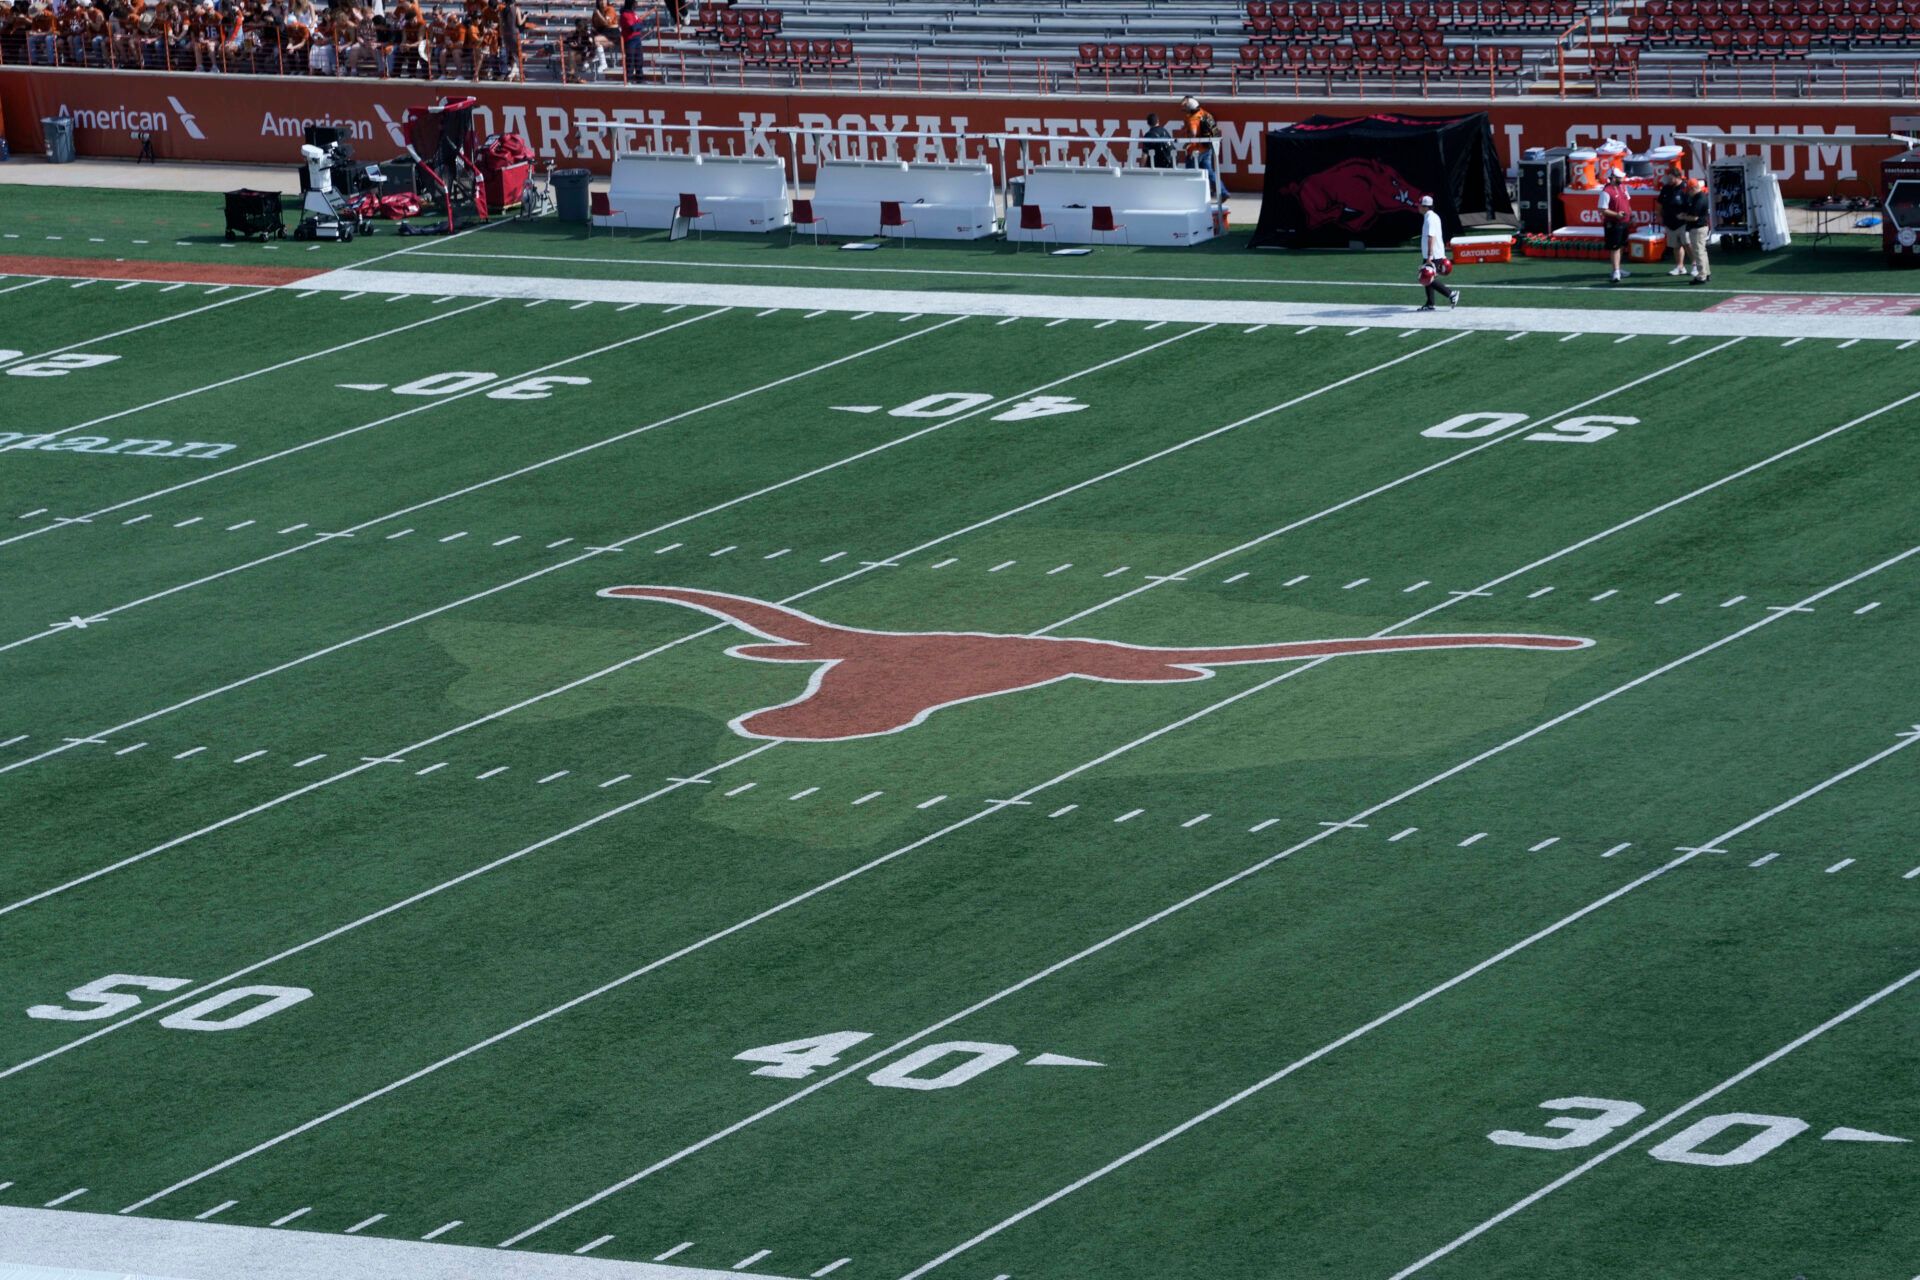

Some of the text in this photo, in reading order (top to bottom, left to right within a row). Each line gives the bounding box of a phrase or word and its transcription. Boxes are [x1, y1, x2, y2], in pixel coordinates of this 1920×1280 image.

[58, 104, 167, 131] American
[738, 111, 778, 158] K
[799, 113, 987, 165] ROYAL
[1574, 164, 1584, 176] G
[1580, 209, 1658, 223] GAADE
[1460, 248, 1501, 257] GATORADE
[0, 349, 122, 377] 2
[26, 973, 314, 1032] 50
[732, 1030, 1020, 1090] 40
[1486, 1096, 1811, 1167] 30
